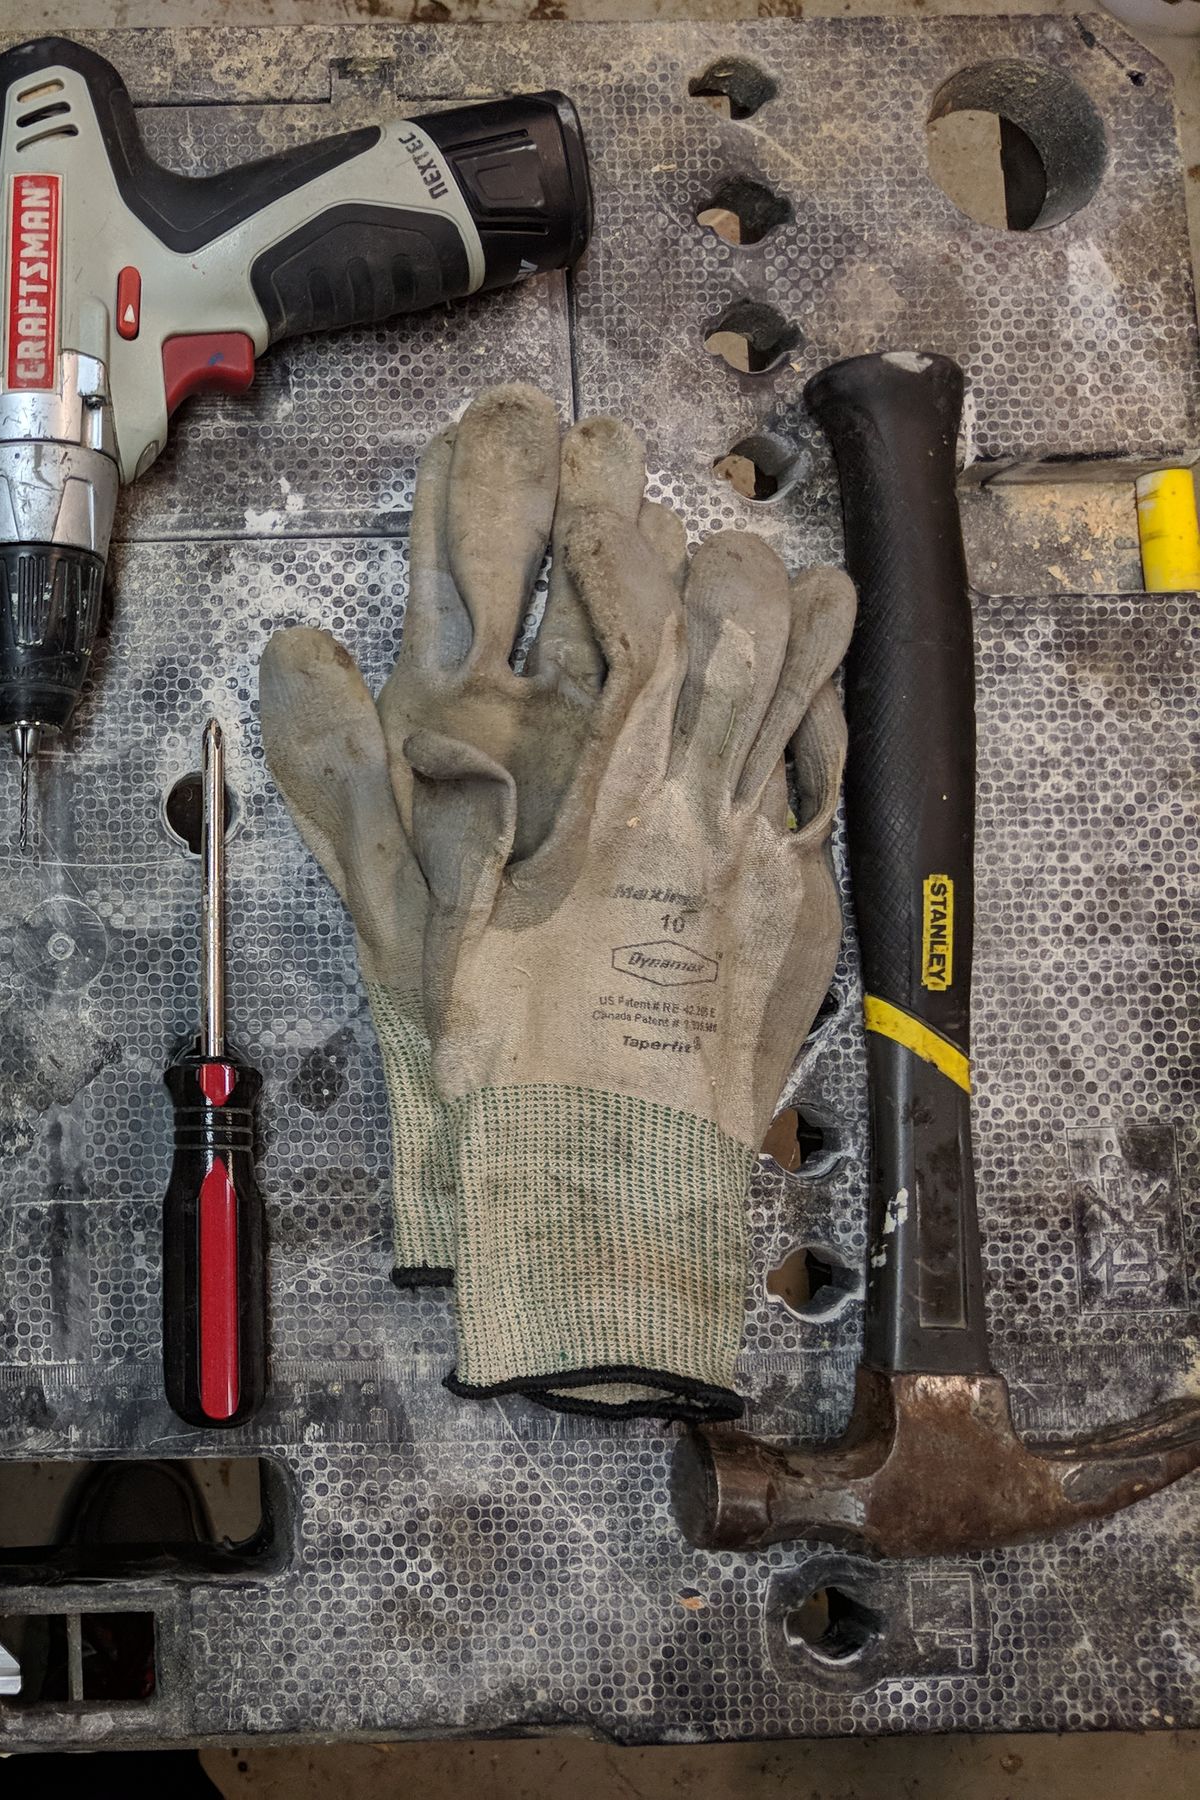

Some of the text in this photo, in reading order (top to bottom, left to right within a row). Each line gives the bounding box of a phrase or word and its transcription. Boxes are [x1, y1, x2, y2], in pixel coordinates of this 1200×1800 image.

[16, 186, 50, 381] CRAFTSMAN
[661, 914, 685, 934] 10
[928, 882, 947, 982] STANLEY
